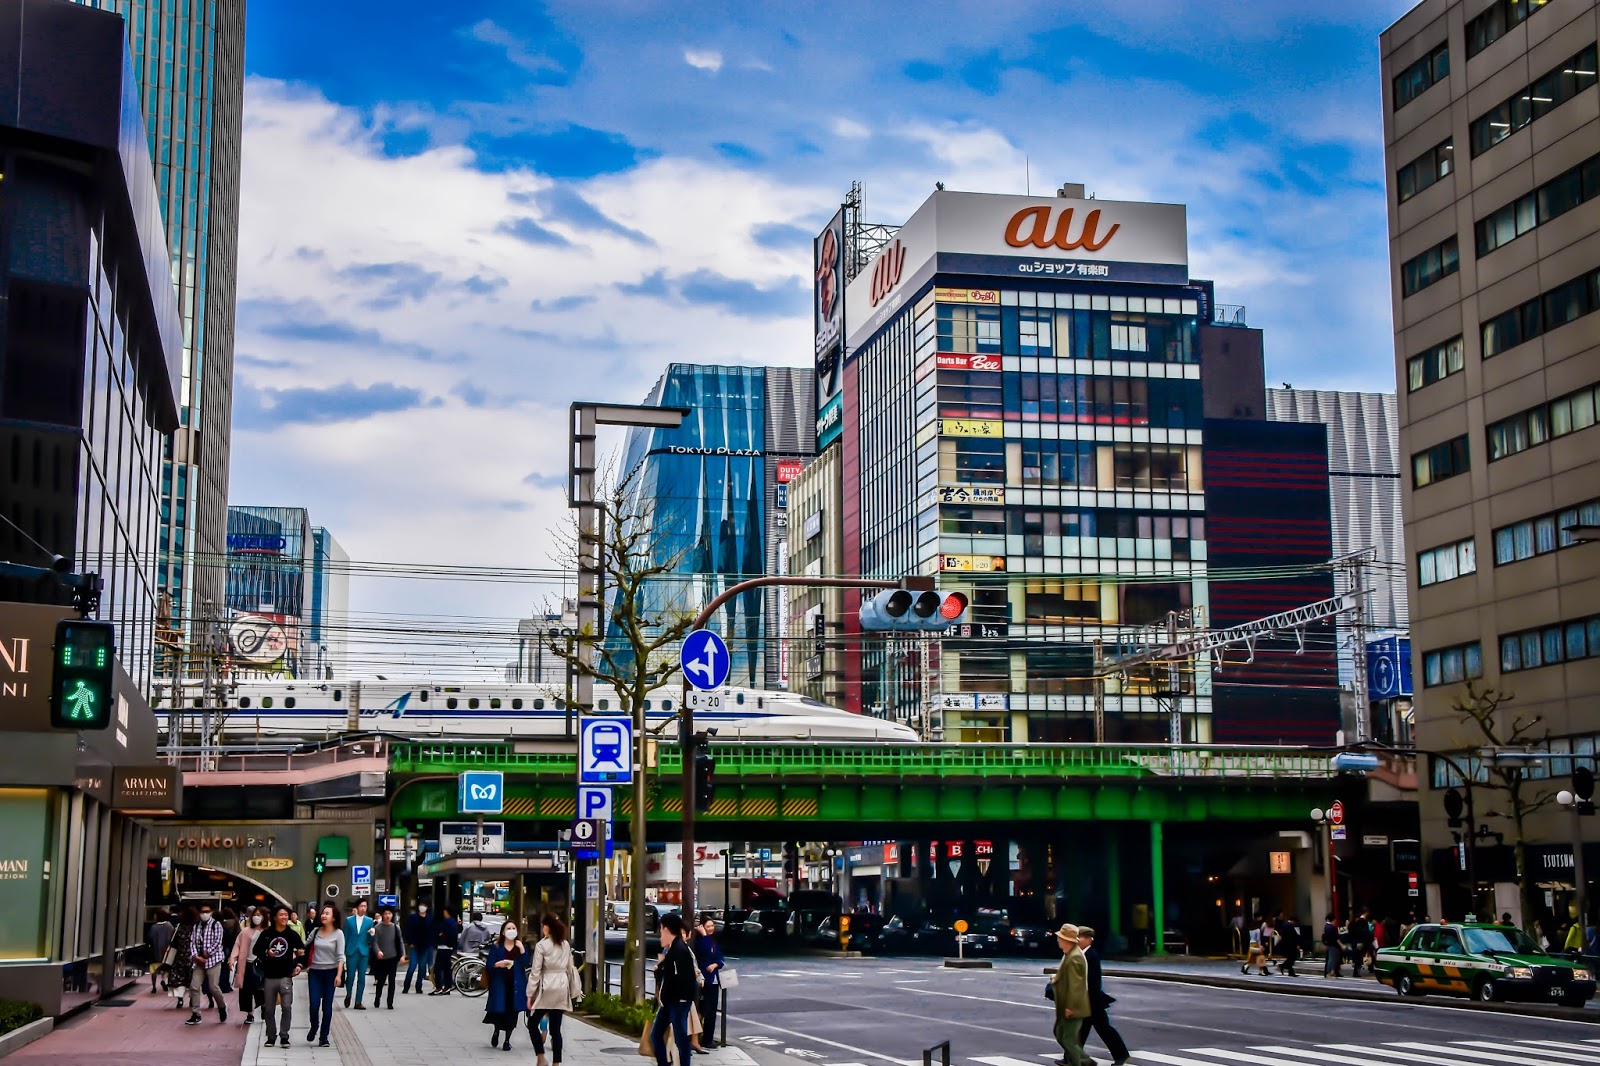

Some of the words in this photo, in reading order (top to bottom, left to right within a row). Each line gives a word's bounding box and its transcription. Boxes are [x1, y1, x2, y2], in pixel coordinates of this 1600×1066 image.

[1004, 205, 1121, 252] au
[937, 356, 954, 365] Darts
[955, 357, 967, 365] Bar
[969, 355, 1000, 370] Bee
[668, 445, 712, 455] TOKYU
[717, 446, 761, 456] PLAZA
[123, 778, 167, 789] ARMANI
[1543, 853, 1575, 868] TSUTSUM
